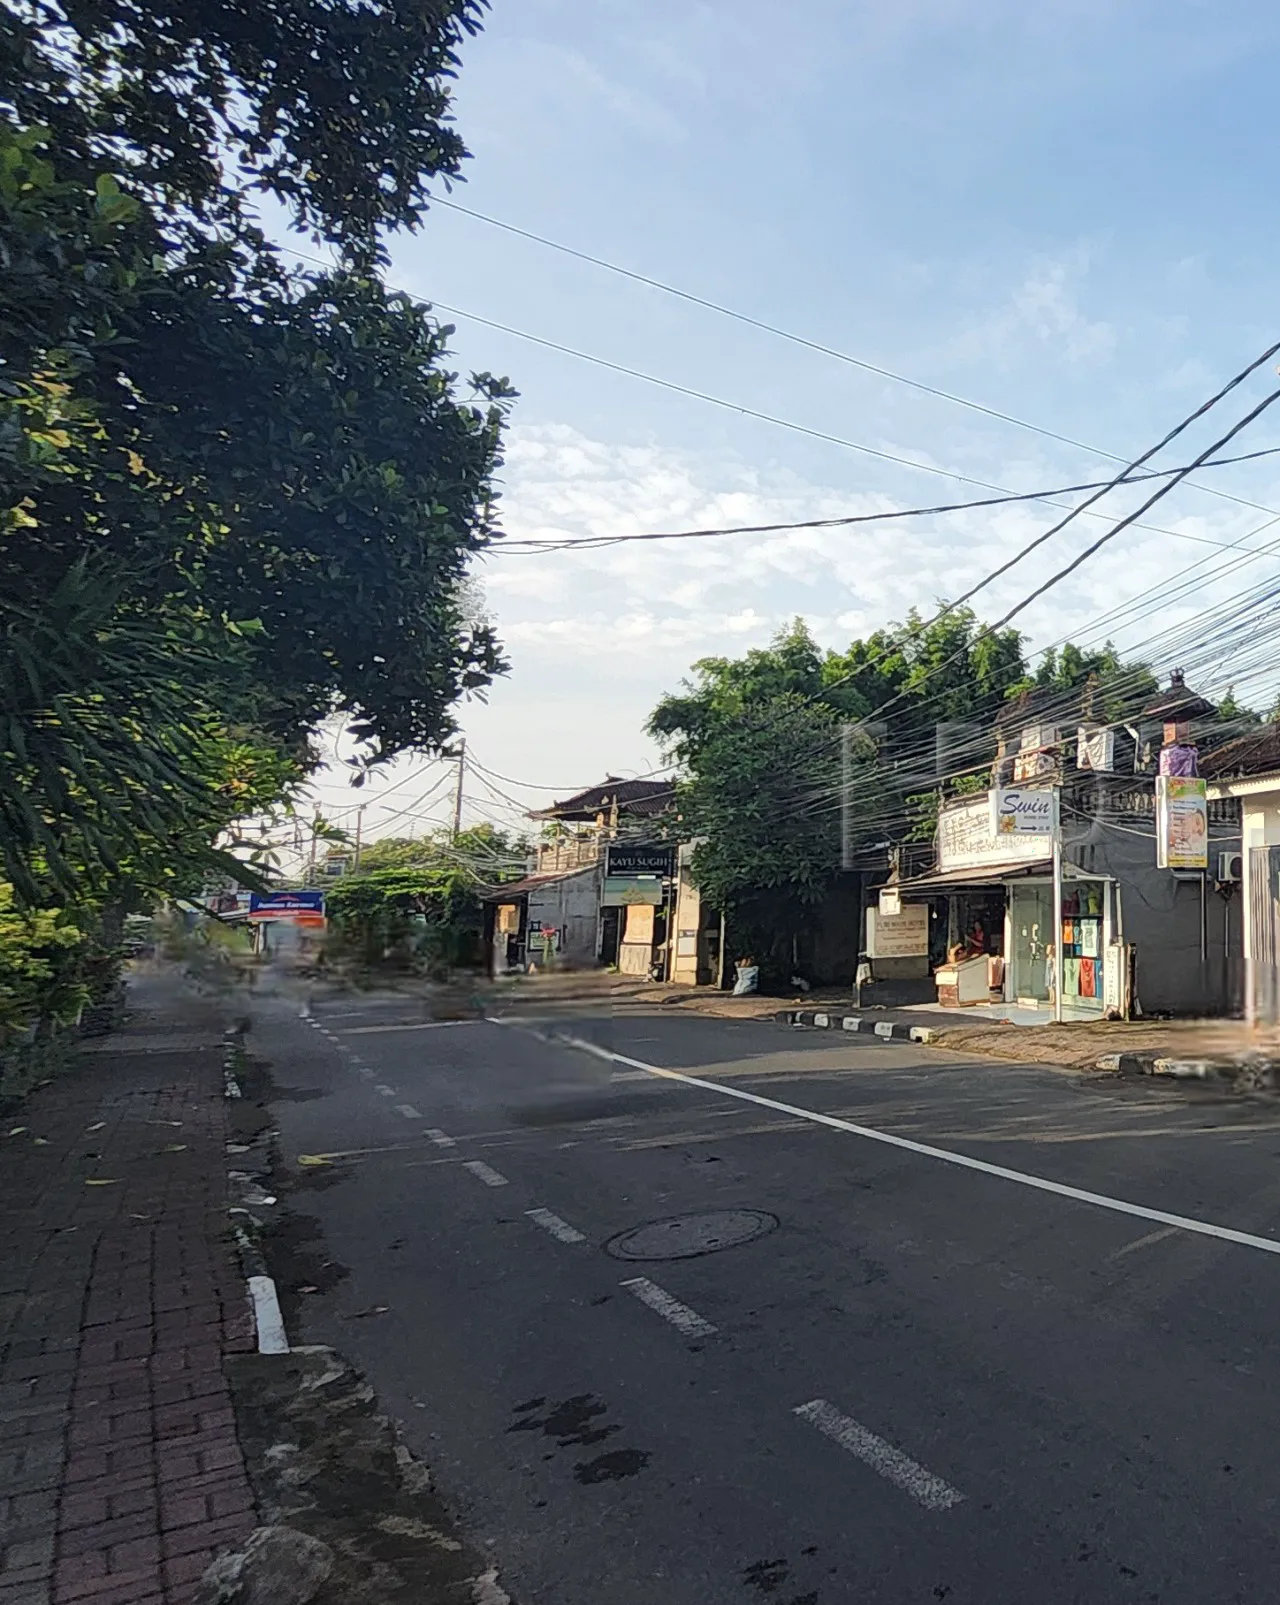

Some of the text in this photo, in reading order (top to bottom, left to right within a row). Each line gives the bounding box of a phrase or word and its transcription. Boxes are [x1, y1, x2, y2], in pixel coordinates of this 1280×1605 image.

[1000, 794, 1049, 814] Swin
[610, 857, 668, 866] KAYU SUGIH
